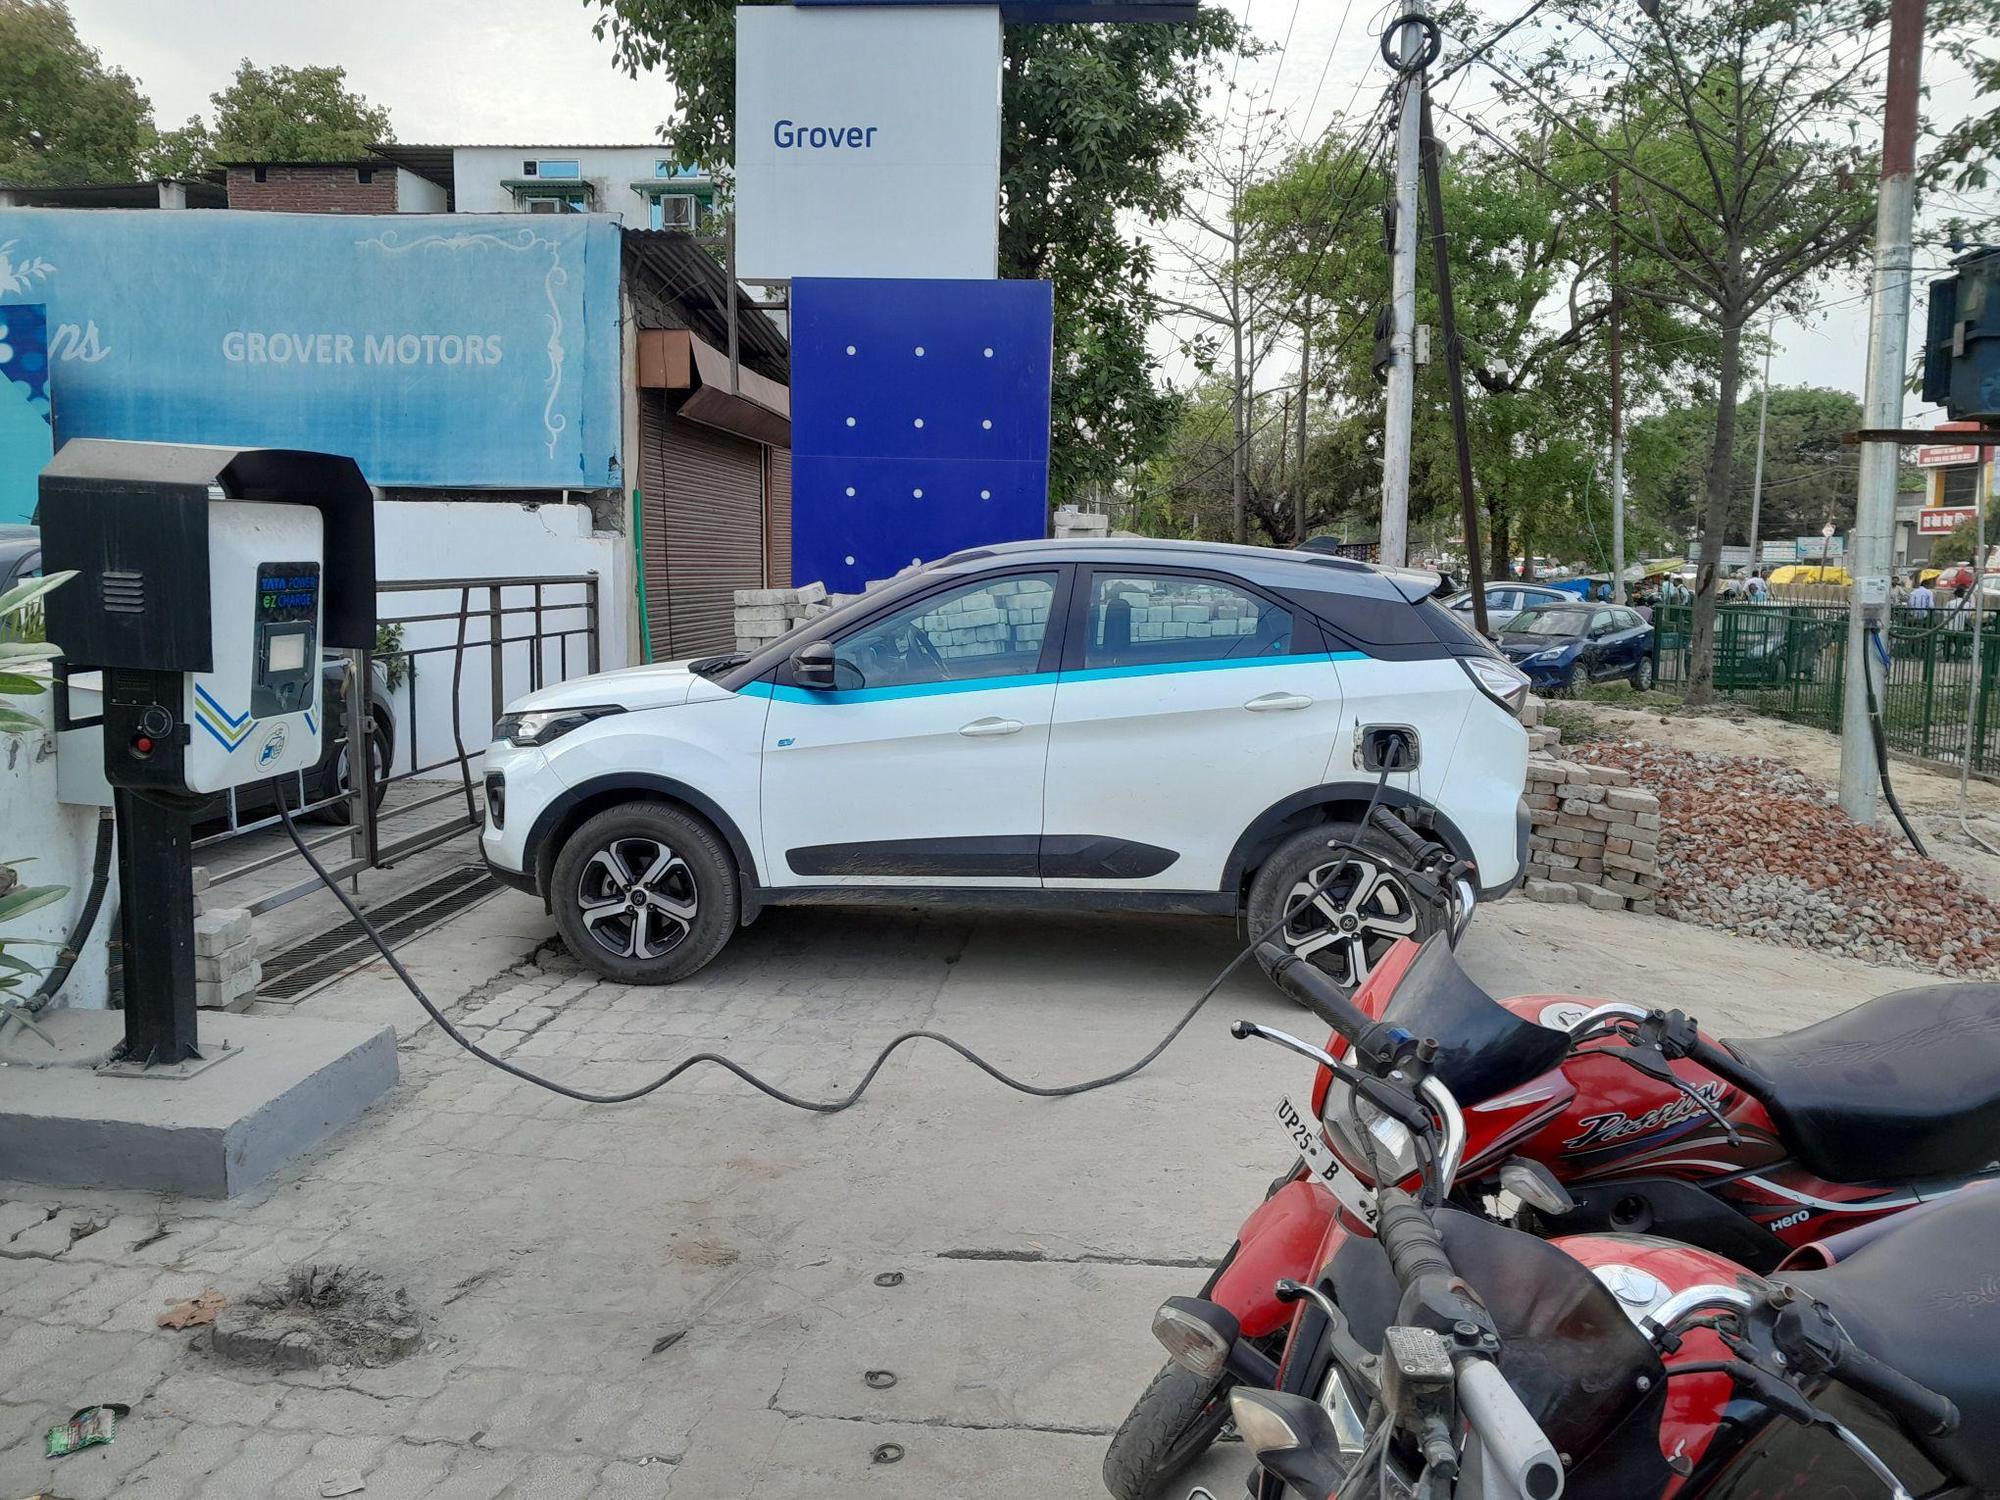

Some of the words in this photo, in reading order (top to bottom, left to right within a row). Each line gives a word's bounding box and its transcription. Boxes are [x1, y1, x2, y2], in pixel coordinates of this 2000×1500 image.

[774, 119, 878, 149] Grover
[222, 331, 355, 364] GROVER
[364, 333, 503, 365] MOTORS
[261, 577, 286, 591] TATA
[1278, 1099, 1313, 1150] UP25
[1321, 1160, 1340, 1181] B
[1770, 1210, 1810, 1232] Hero
